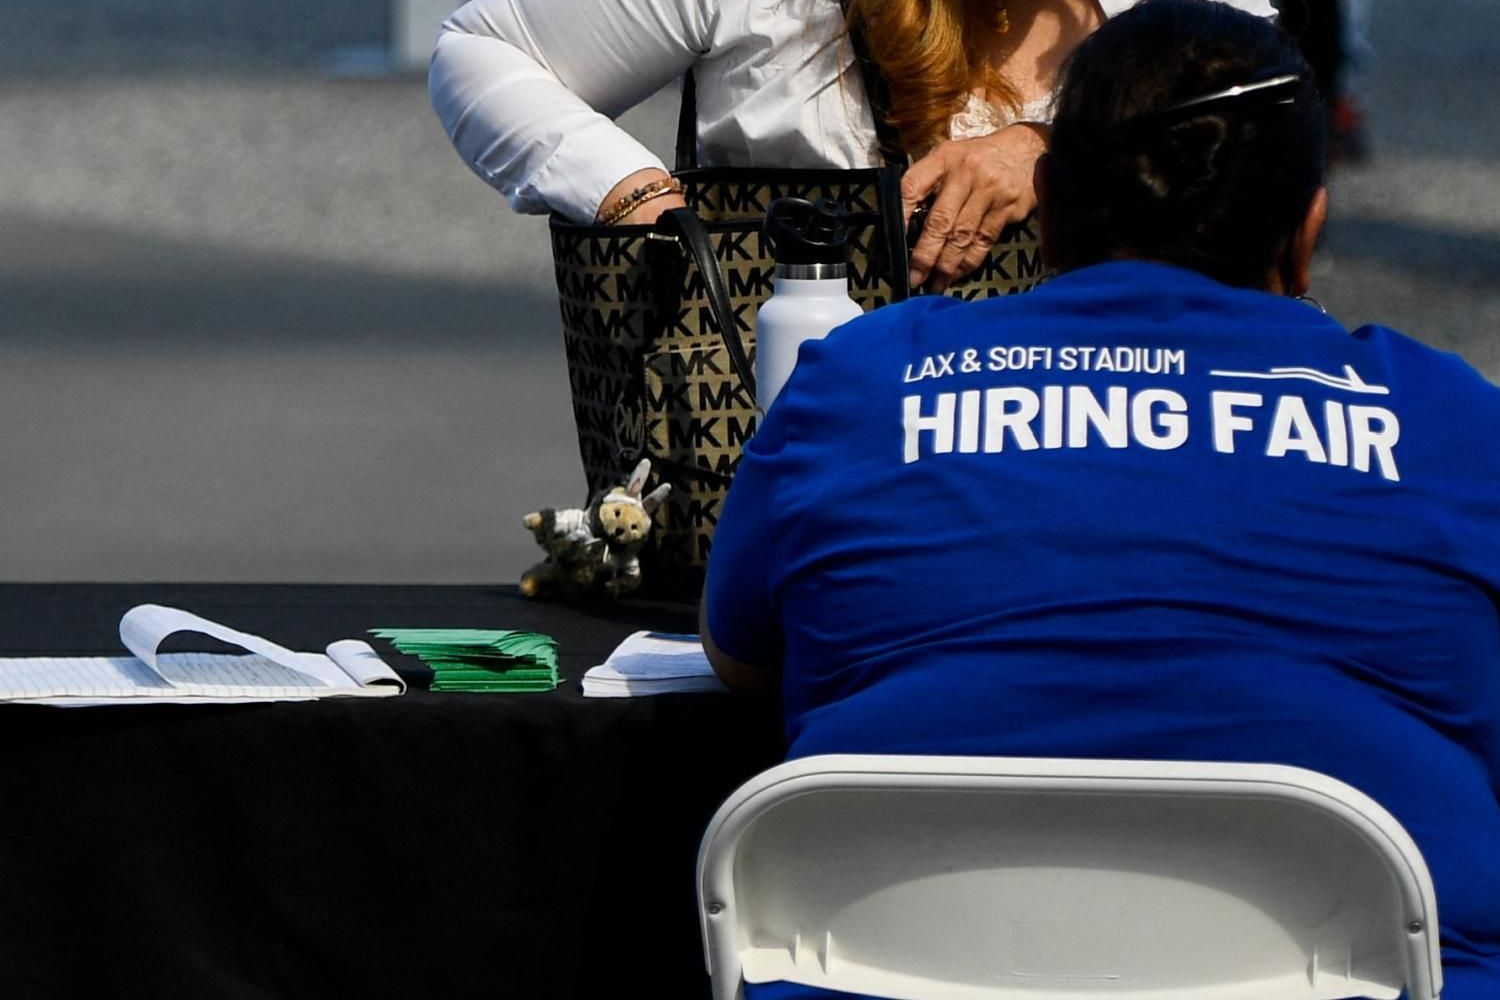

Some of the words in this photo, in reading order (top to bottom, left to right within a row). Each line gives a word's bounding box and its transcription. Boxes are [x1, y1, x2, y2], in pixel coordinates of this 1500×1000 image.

[670, 348, 723, 376] MK
[903, 354, 955, 383] LAX
[963, 349, 982, 373] &
[987, 347, 1053, 372] SOFI
[1058, 348, 1186, 375] STADIUM
[700, 381, 752, 411] MK
[669, 417, 722, 448] MK
[903, 386, 1189, 464] HIRING
[1211, 390, 1401, 482] FAIR
